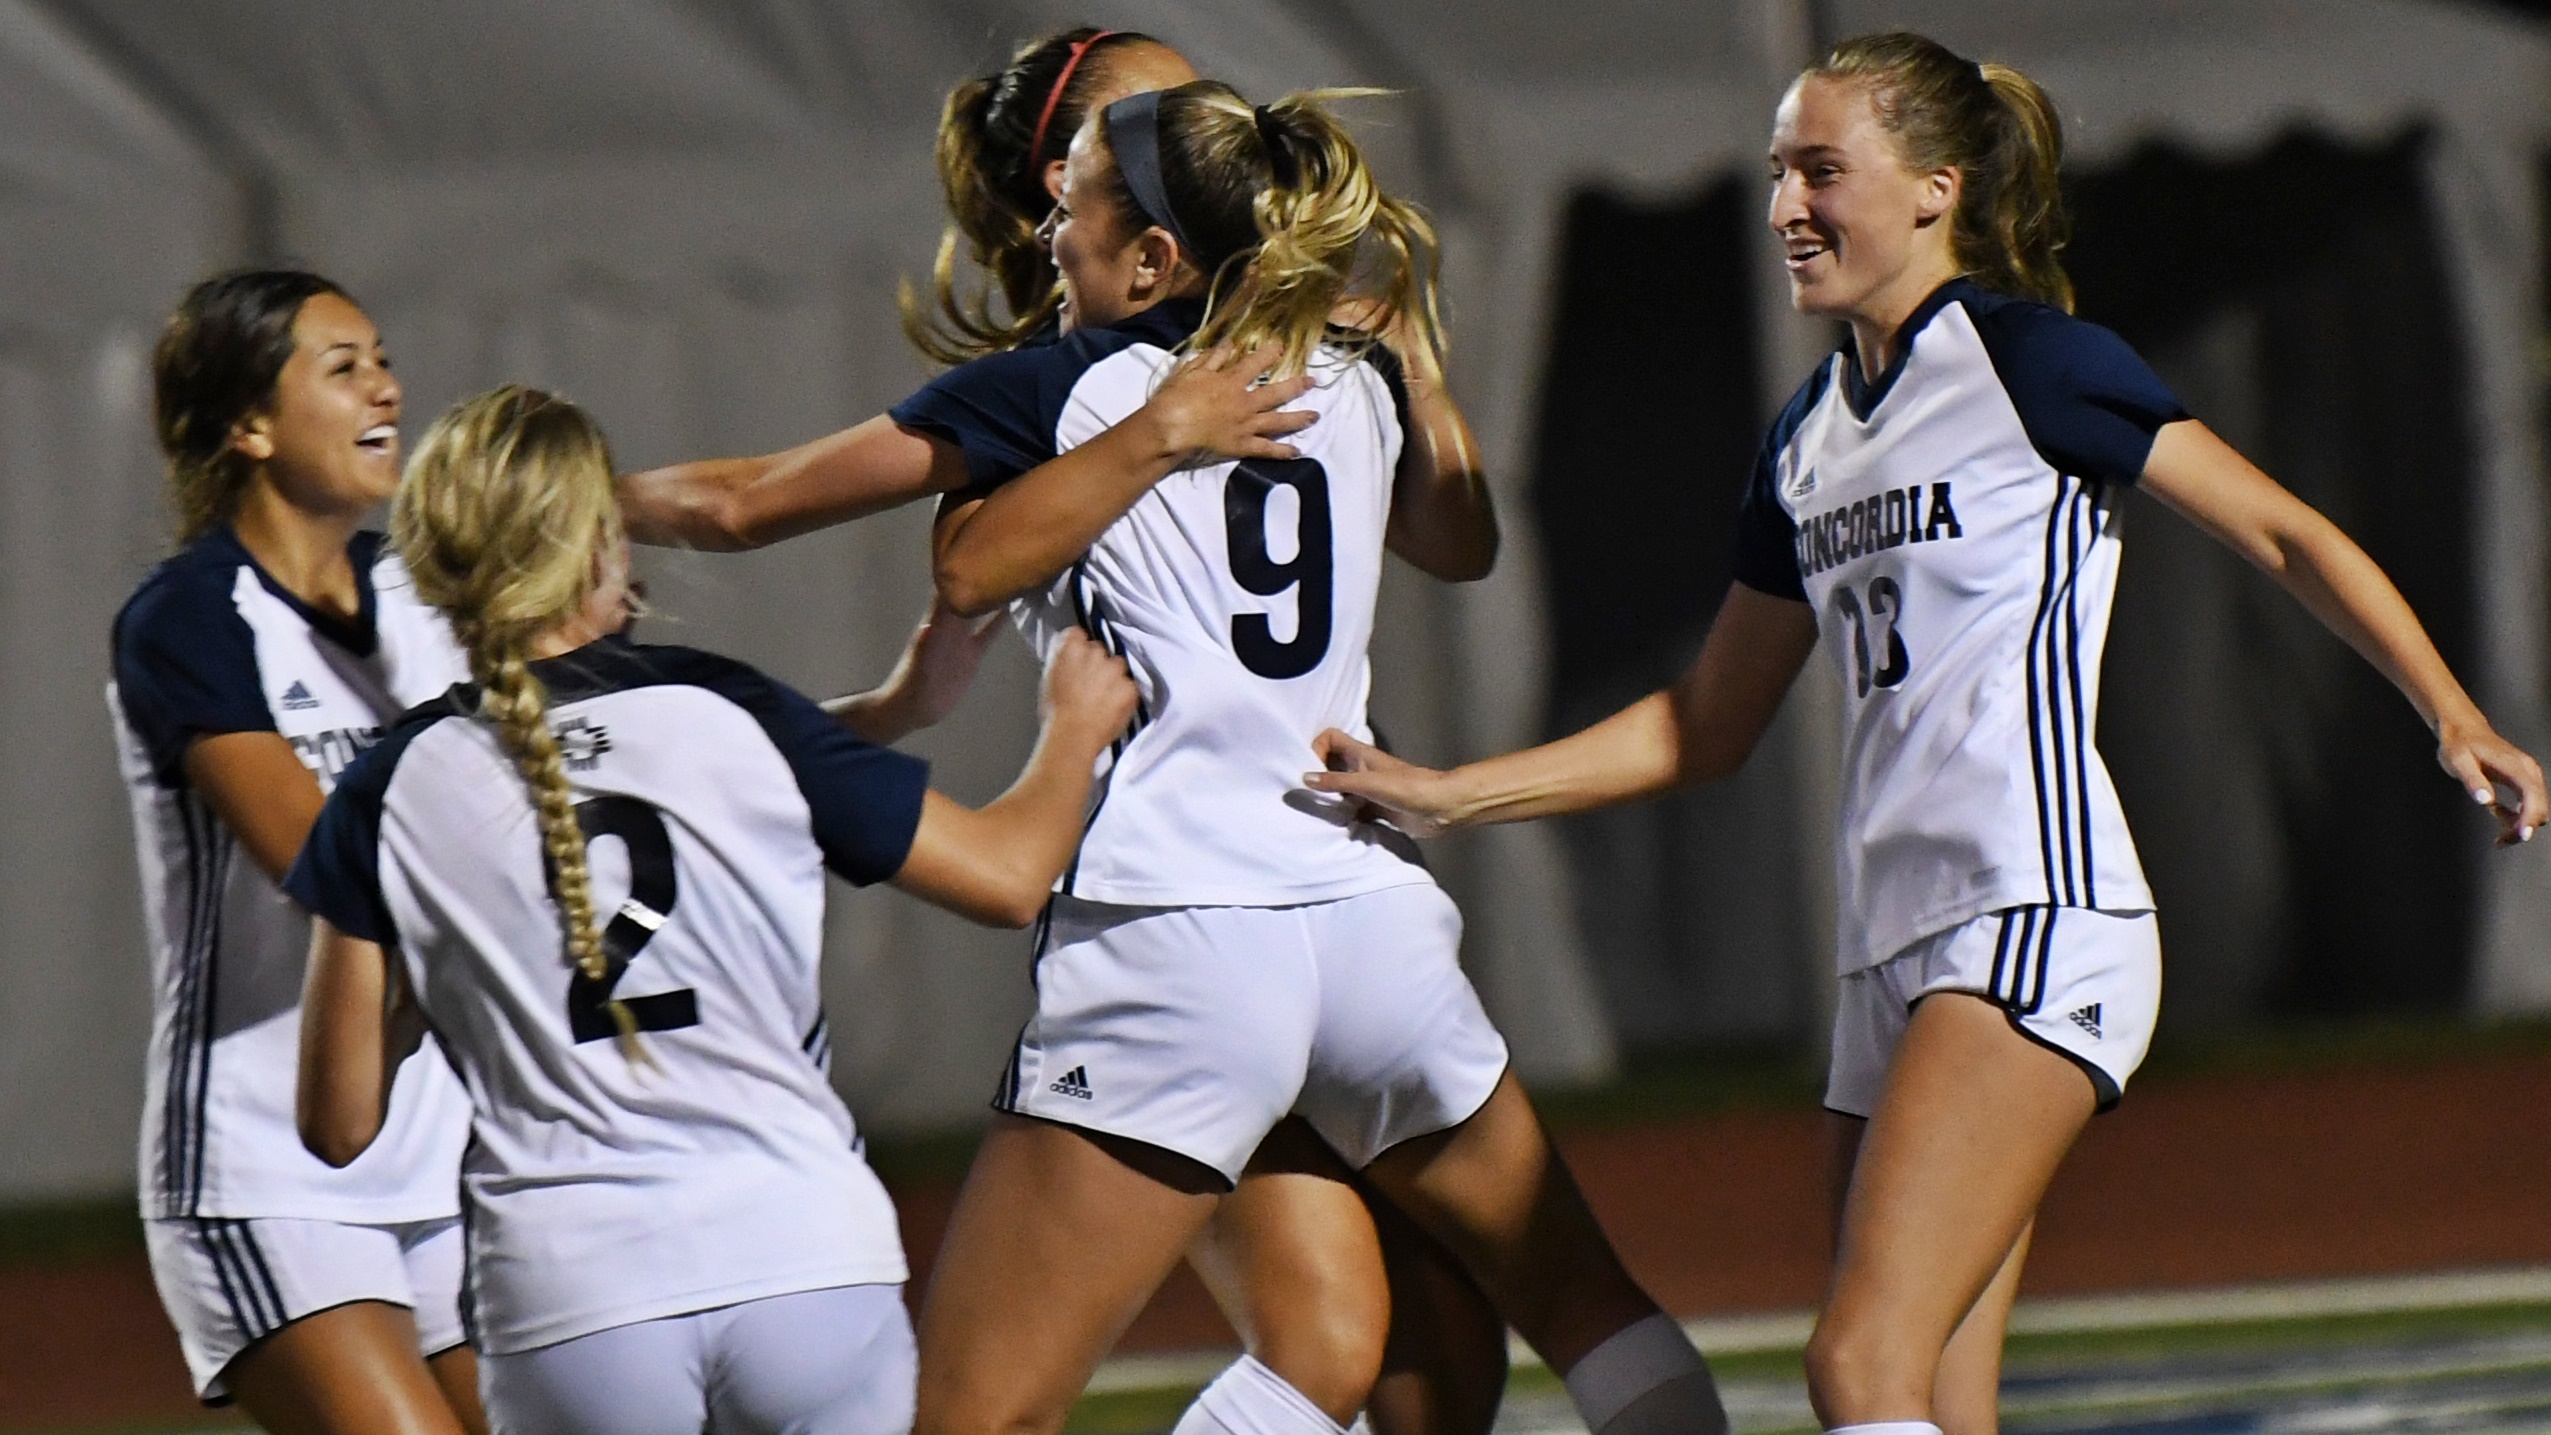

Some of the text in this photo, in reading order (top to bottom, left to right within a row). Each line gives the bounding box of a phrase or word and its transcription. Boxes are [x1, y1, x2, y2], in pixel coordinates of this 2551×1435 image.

[1224, 457, 1333, 680] 9
[1796, 481, 1963, 577] ONCORDIA
[543, 796, 701, 1045] 2
[2069, 1011, 2102, 1040] adidas
[1049, 1082, 1093, 1100] adidas
